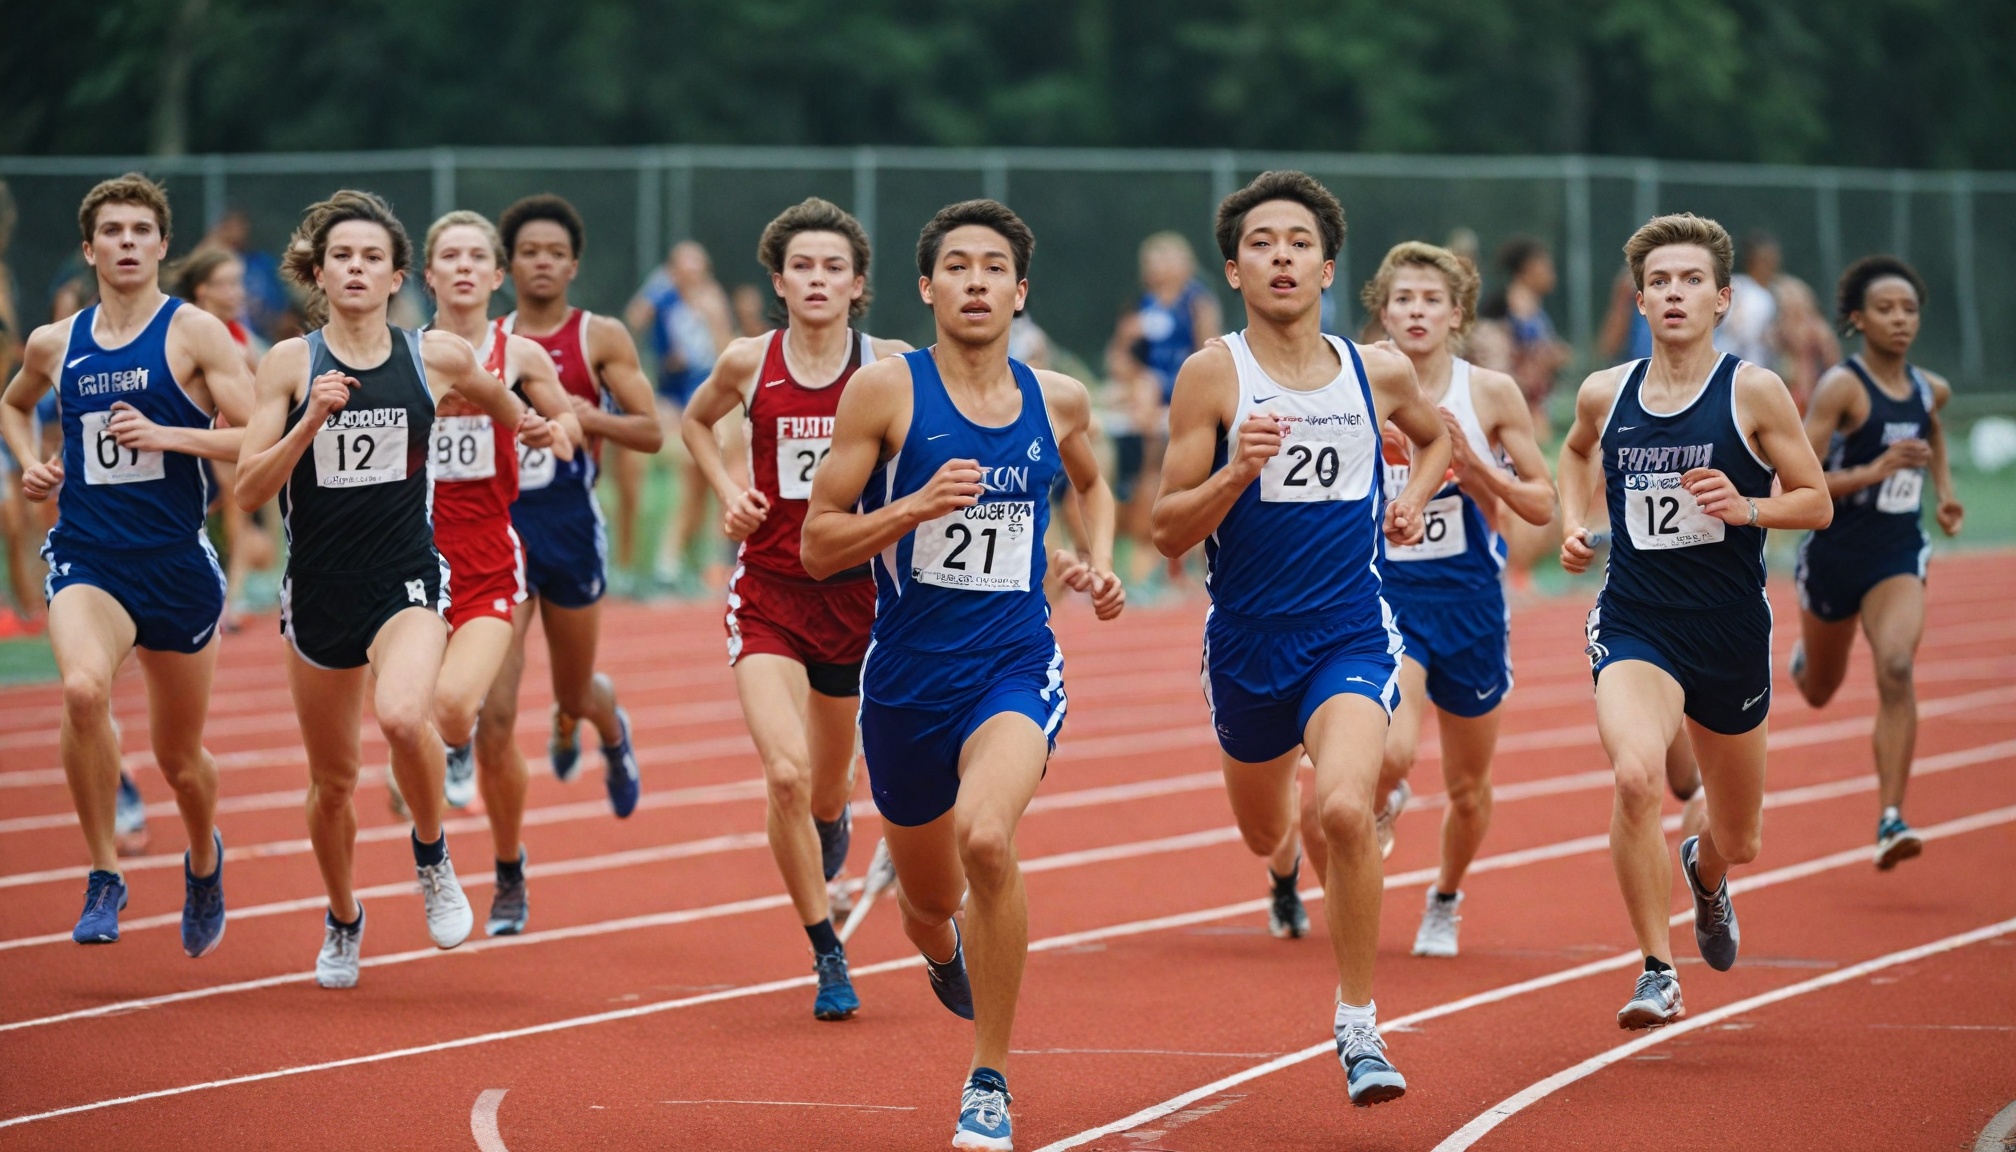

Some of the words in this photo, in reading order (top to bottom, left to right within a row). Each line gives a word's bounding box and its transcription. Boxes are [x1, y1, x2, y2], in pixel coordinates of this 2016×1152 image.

[337, 434, 375, 471] 12
[797, 447, 831, 482] 2
[1283, 444, 1340, 488] 20
[1645, 496, 1680, 536] 12
[942, 522, 997, 574] 21
